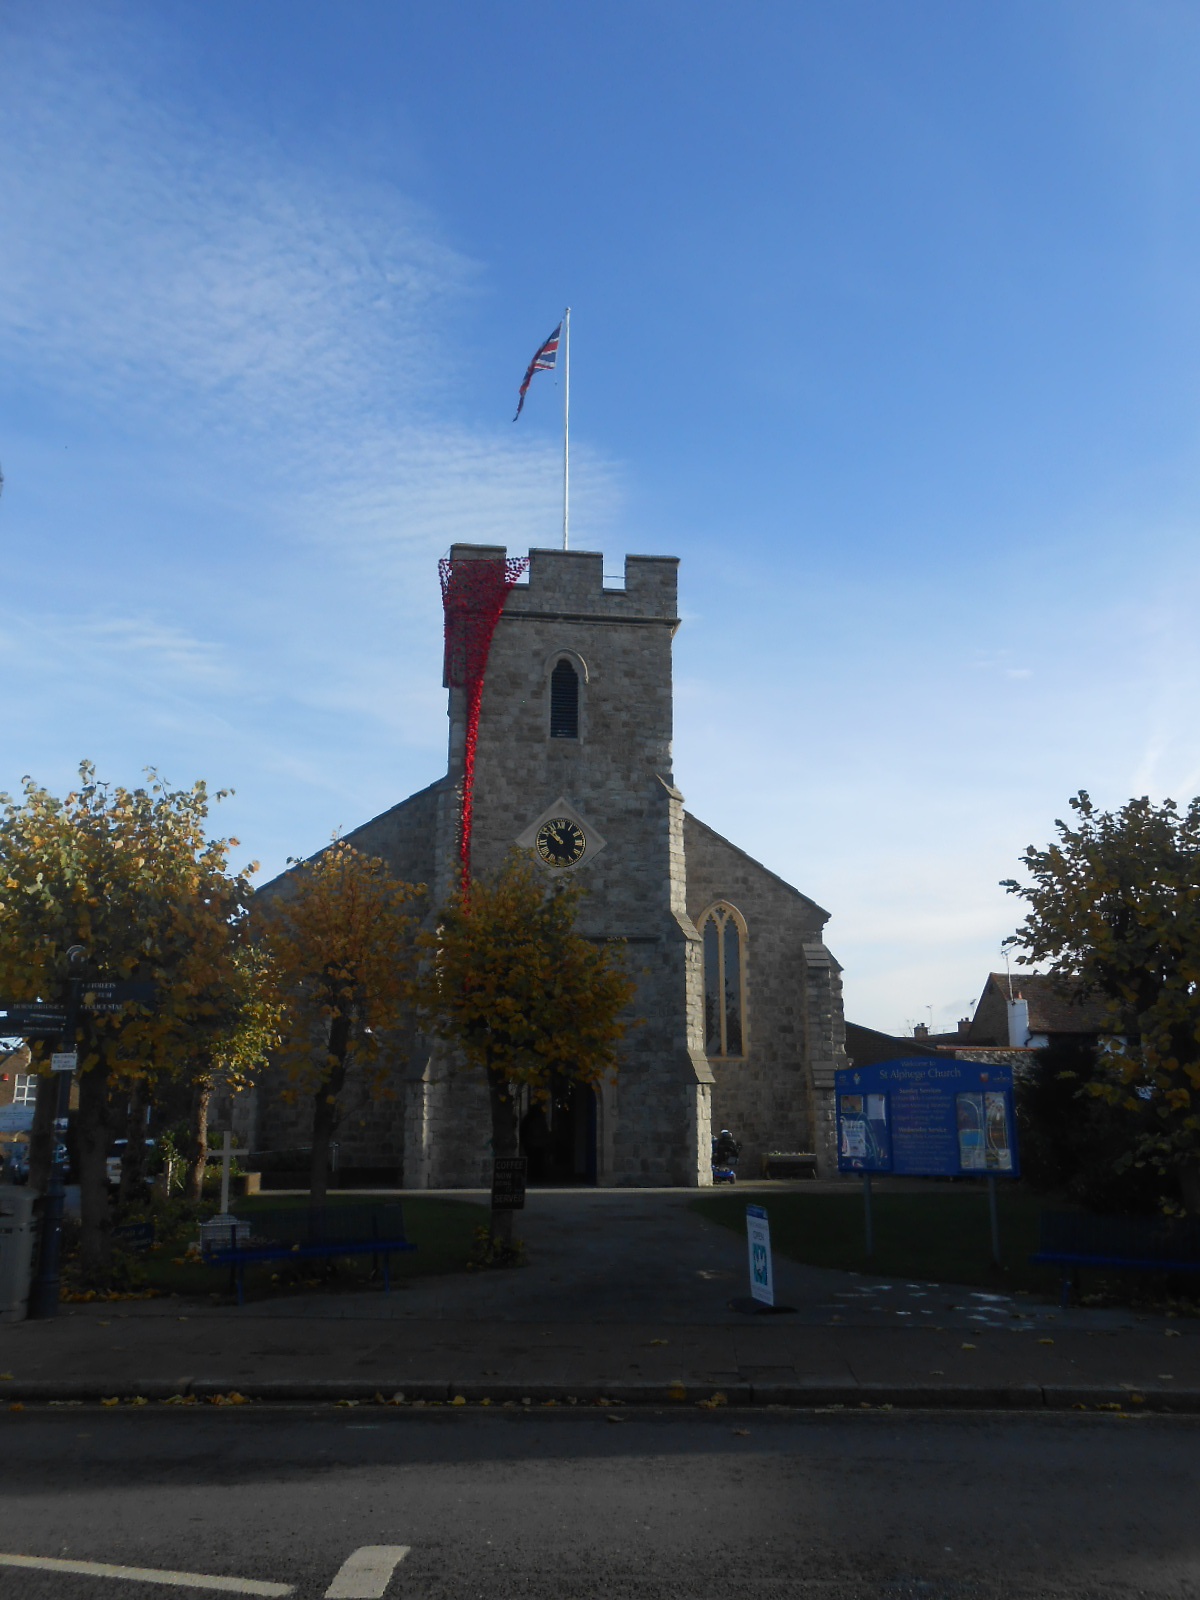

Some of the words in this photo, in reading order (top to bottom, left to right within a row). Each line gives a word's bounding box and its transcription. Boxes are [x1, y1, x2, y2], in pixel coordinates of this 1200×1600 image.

[890, 1068, 926, 1081] Alphege
[927, 1066, 961, 1078] Church
[496, 1160, 525, 1170] COFFEE
[495, 1171, 512, 1180] NOW
[493, 1193, 524, 1204] SERVED
